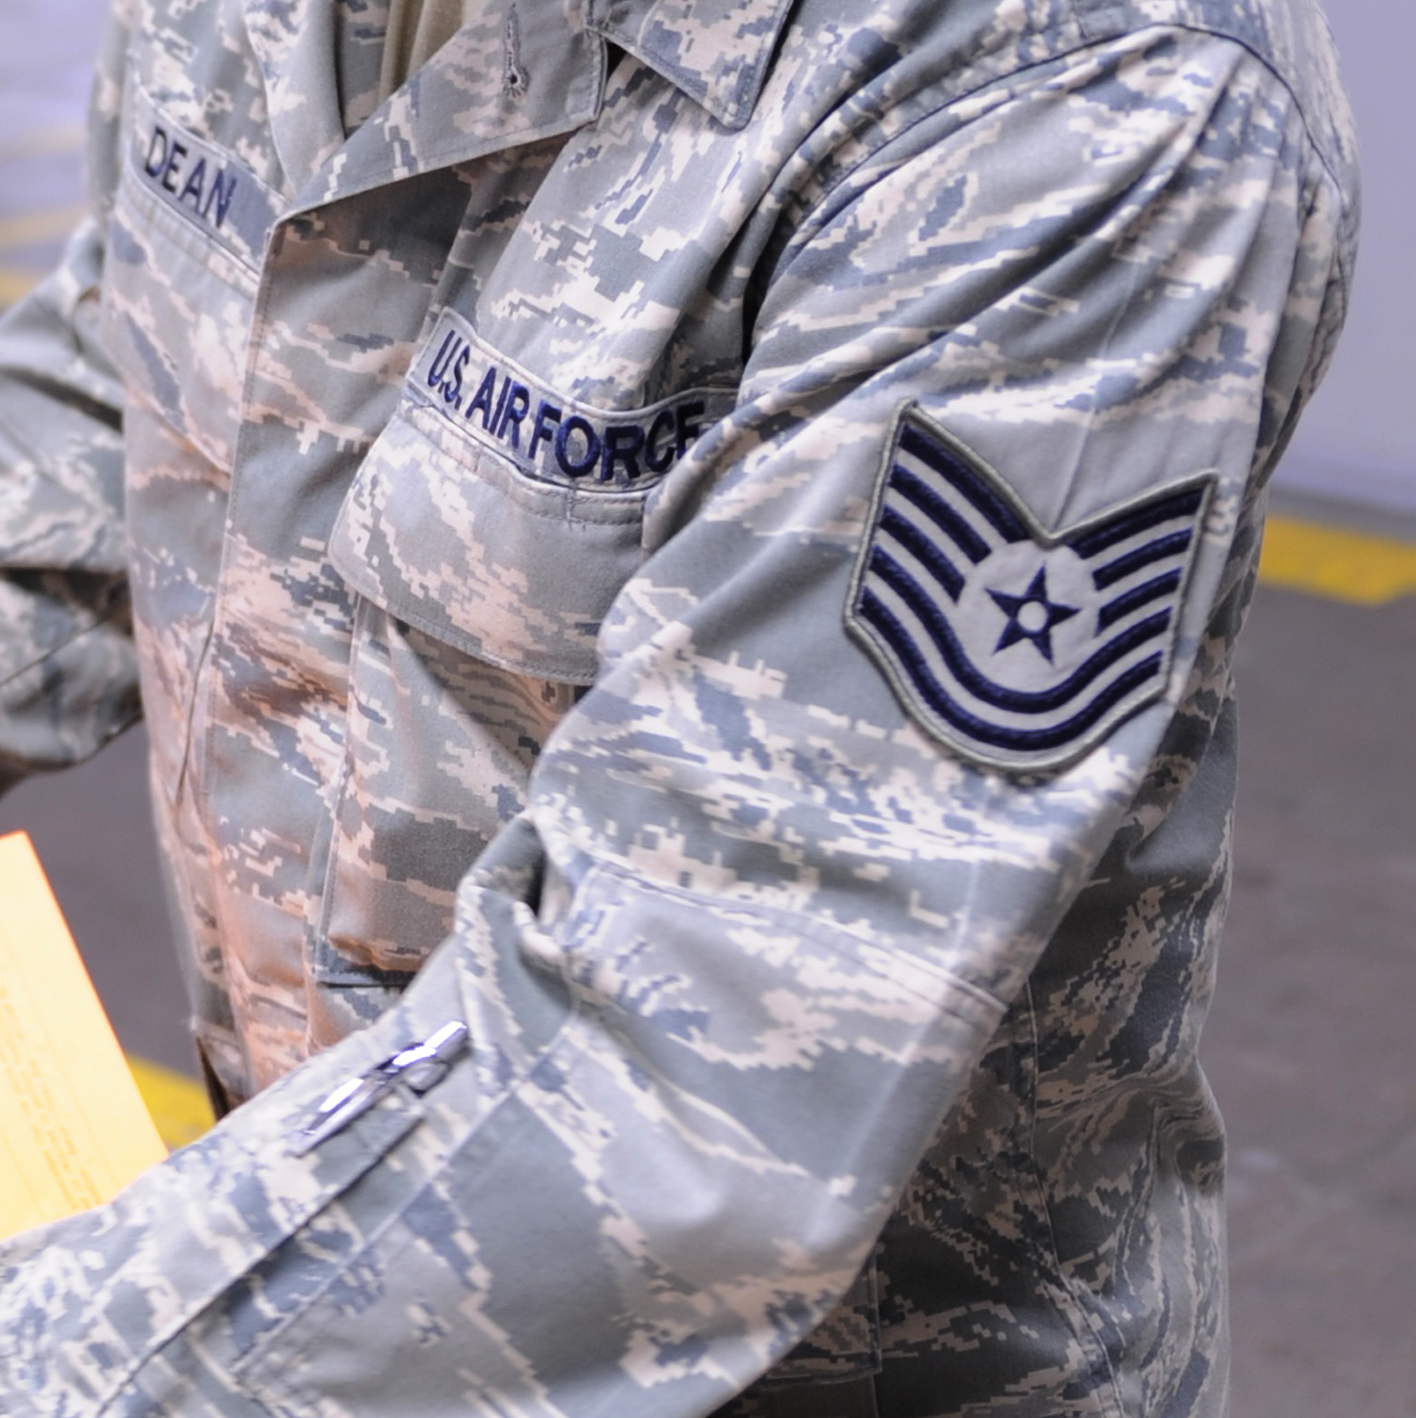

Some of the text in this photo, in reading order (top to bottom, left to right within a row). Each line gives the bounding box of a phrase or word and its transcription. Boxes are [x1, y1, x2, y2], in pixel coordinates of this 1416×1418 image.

[144, 125, 237, 228] DEAN
[427, 329, 705, 481] U.S. AIR FORCE
